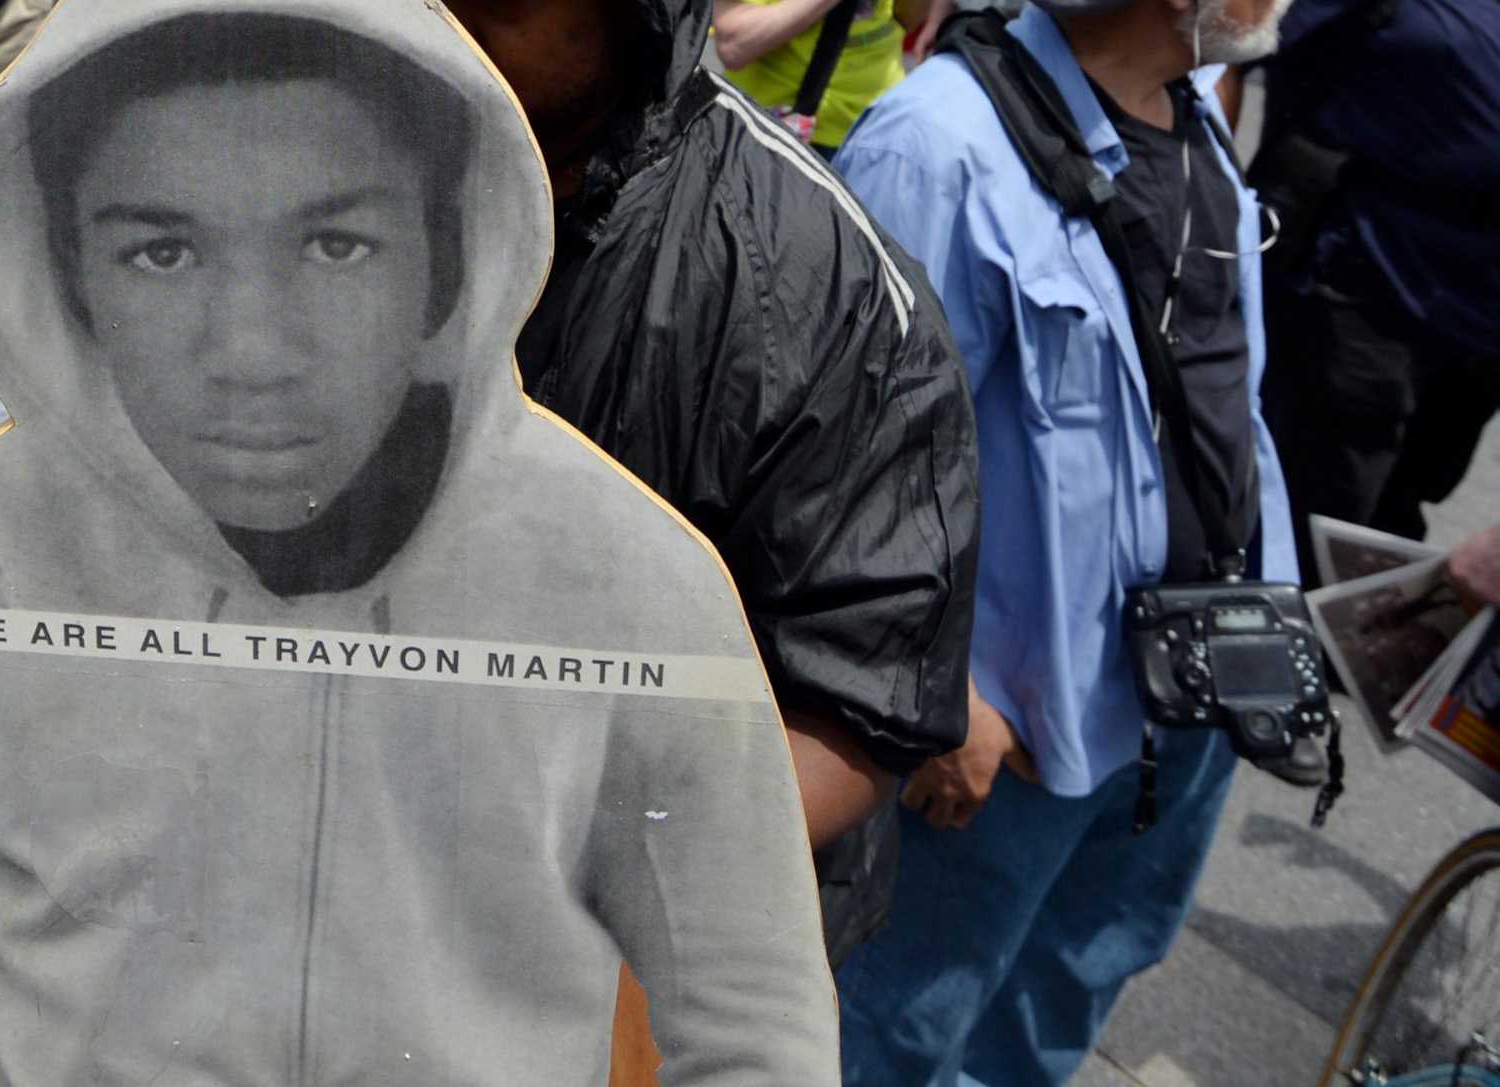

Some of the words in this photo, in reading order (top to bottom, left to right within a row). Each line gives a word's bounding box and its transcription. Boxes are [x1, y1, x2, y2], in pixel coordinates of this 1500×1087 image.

[31, 622, 117, 650] ARE
[140, 629, 221, 657] ALL
[244, 635, 460, 674] TRAYVON
[487, 653, 666, 688] MARTIN
